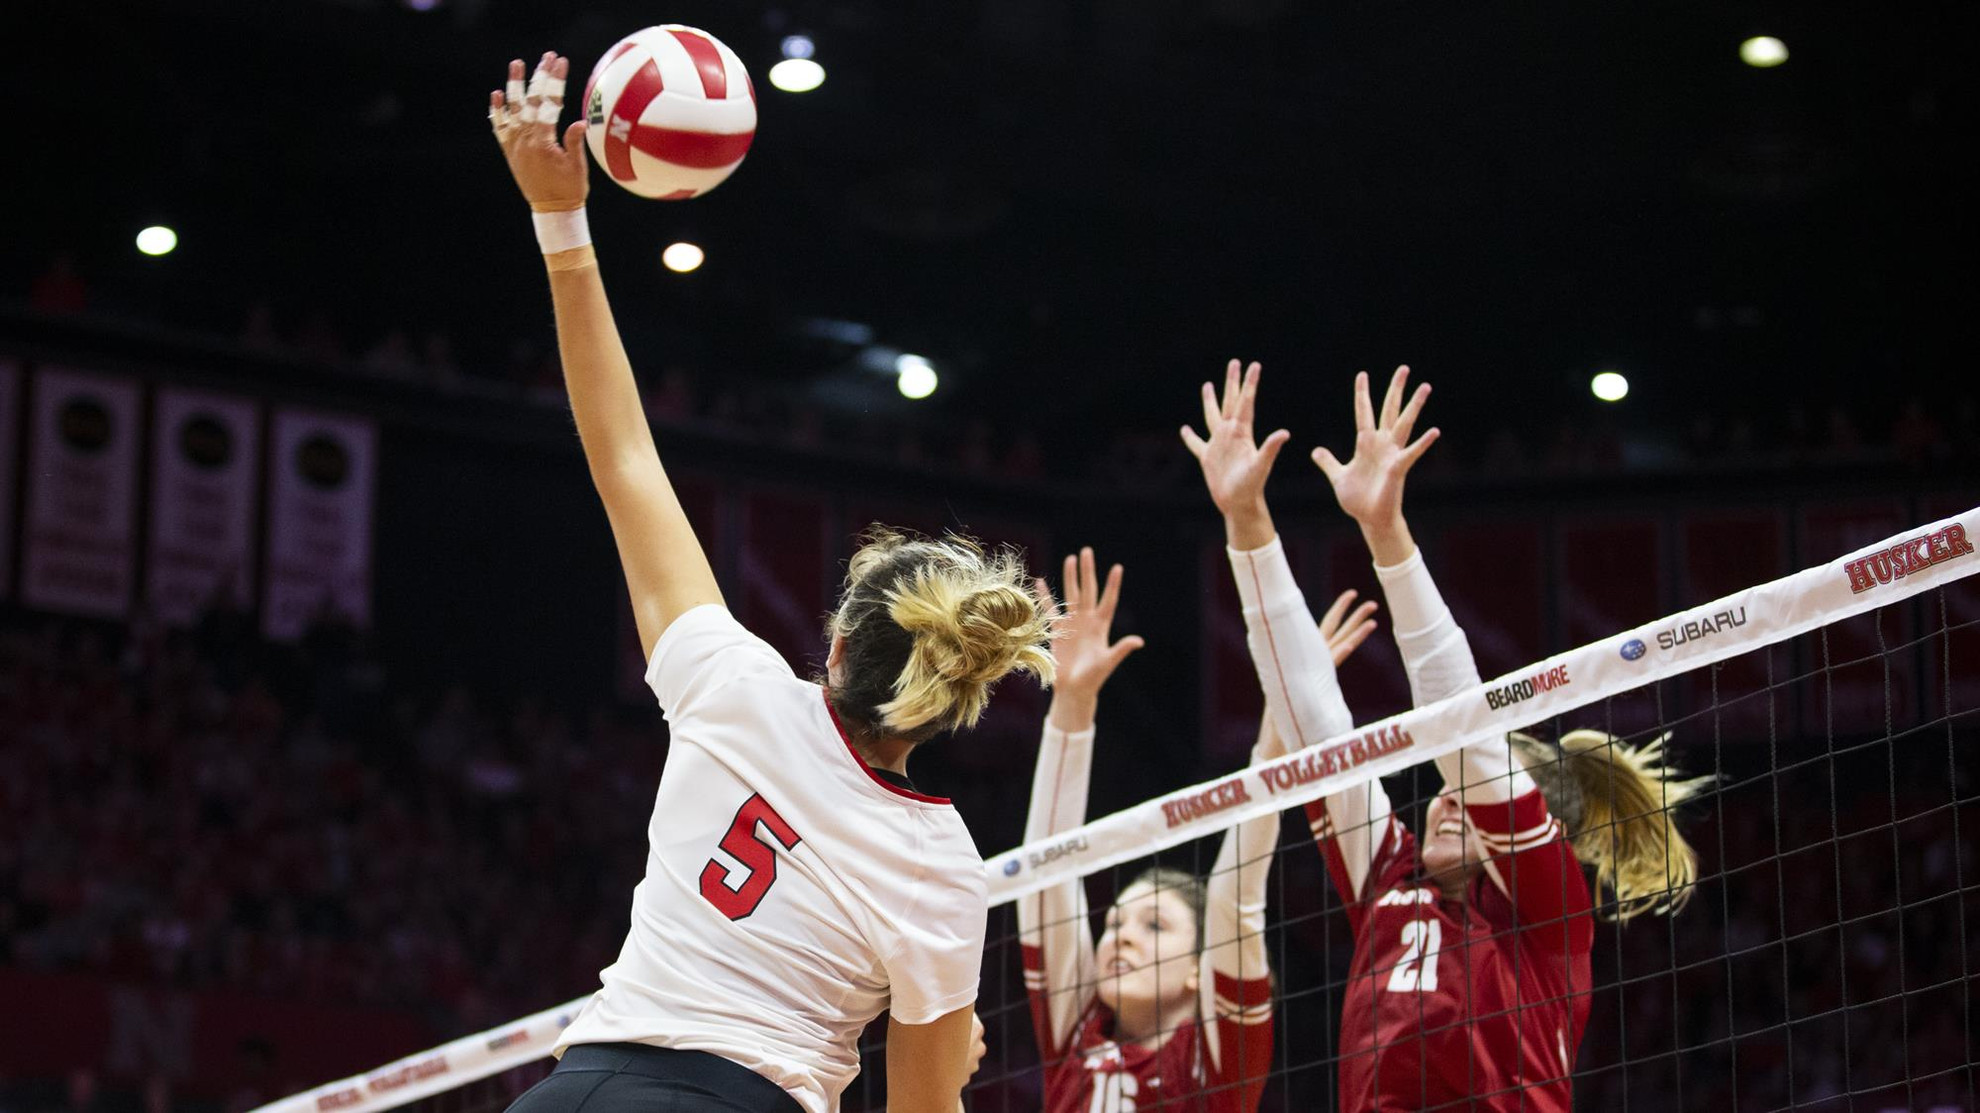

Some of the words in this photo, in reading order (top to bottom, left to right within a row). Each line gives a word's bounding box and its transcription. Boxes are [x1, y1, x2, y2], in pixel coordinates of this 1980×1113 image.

[1844, 522, 1975, 594] HUSKER
[1656, 606, 1747, 651] SUBARU
[1485, 664, 1570, 711] BEARDMORE
[1161, 778, 1251, 829] HUSKER
[1259, 724, 1415, 795] VOLLEYBALL
[699, 791, 803, 922] 5
[1386, 918, 1442, 992] 21
